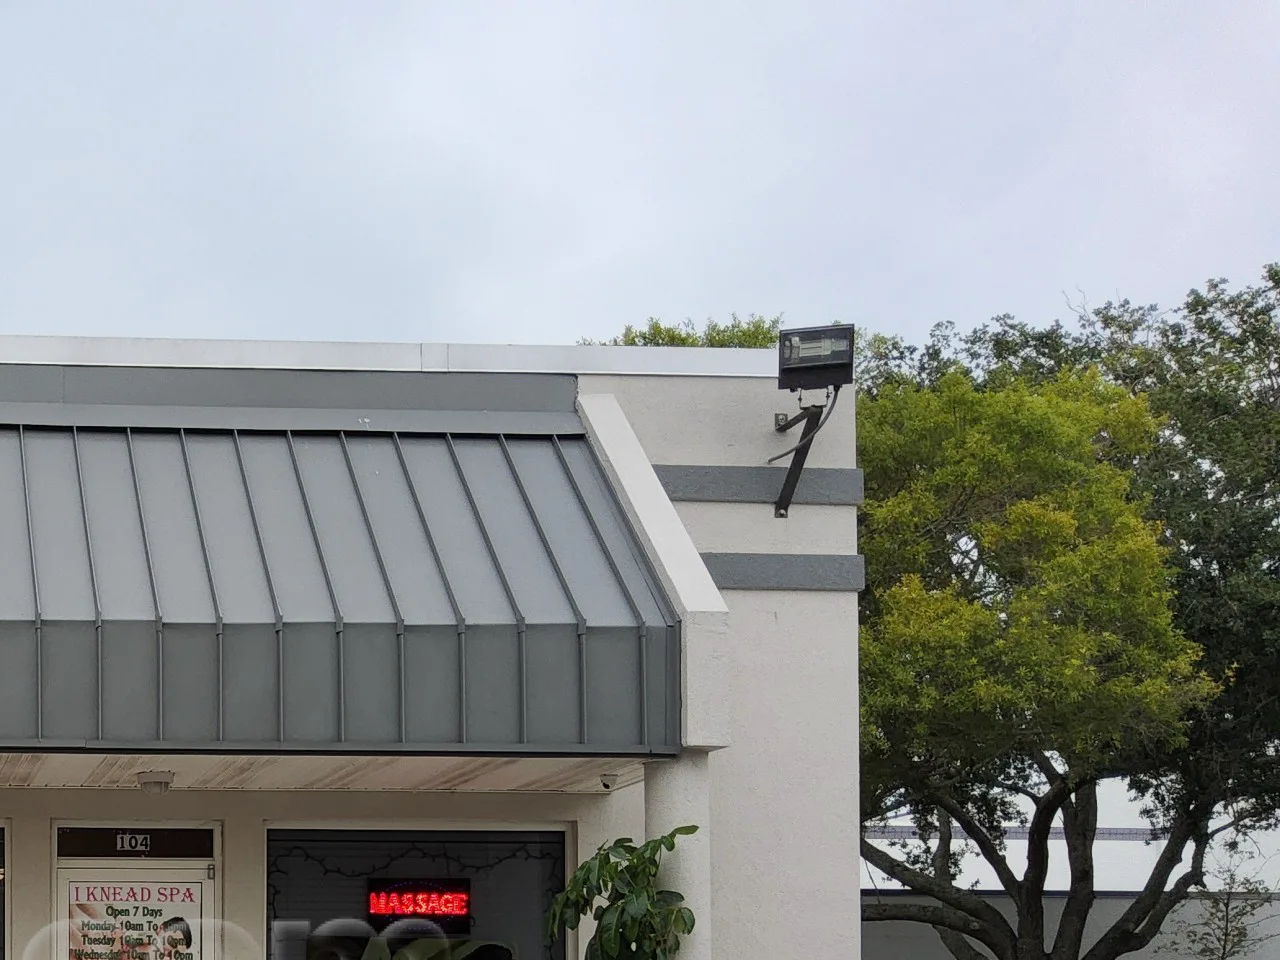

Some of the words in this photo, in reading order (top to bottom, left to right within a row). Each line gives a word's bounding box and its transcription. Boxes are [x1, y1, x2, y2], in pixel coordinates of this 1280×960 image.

[119, 835, 149, 850] 104
[75, 886, 80, 902] I
[86, 886, 151, 902] KNEAD
[157, 887, 196, 903] SPA
[369, 892, 468, 914] MASSAGE
[106, 906, 130, 919] Open
[133, 906, 139, 916] 7
[143, 906, 162, 918] Days
[81, 920, 116, 932] Monday
[120, 920, 144, 931] 10am
[146, 921, 158, 931] To
[81, 935, 116, 947] Tuesday
[146, 936, 158, 946] To
[153, 951, 165, 960] To
